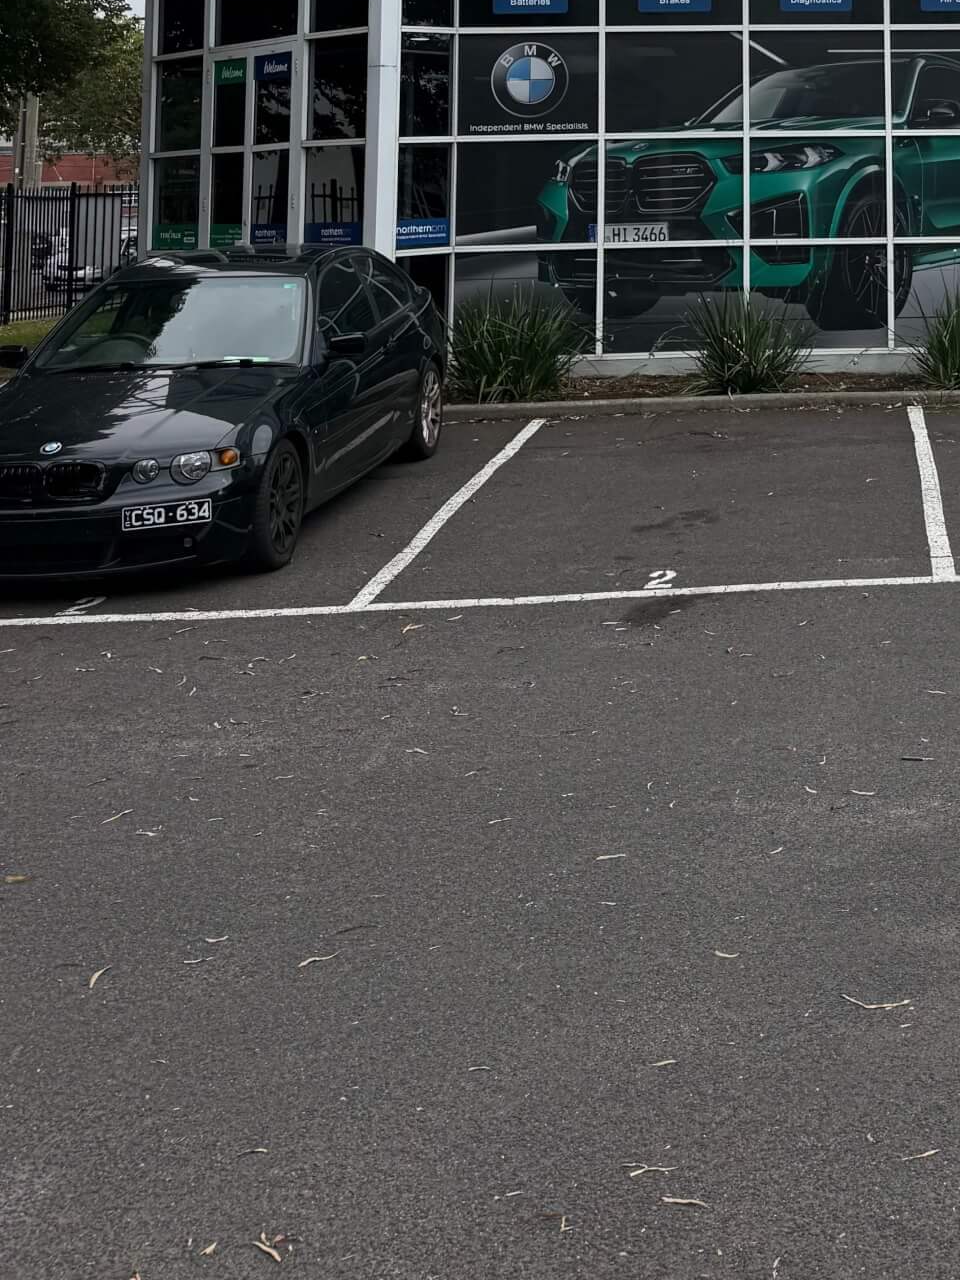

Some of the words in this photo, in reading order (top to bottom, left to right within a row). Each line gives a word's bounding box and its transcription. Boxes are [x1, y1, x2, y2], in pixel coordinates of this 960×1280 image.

[500, 45, 561, 68] BMW
[264, 60, 288, 74] Welcome
[470, 124, 521, 133] Independent
[523, 123, 544, 131] BMW
[546, 122, 588, 131] Specialists
[632, 226, 666, 242] 3466
[644, 570, 676, 588] 2
